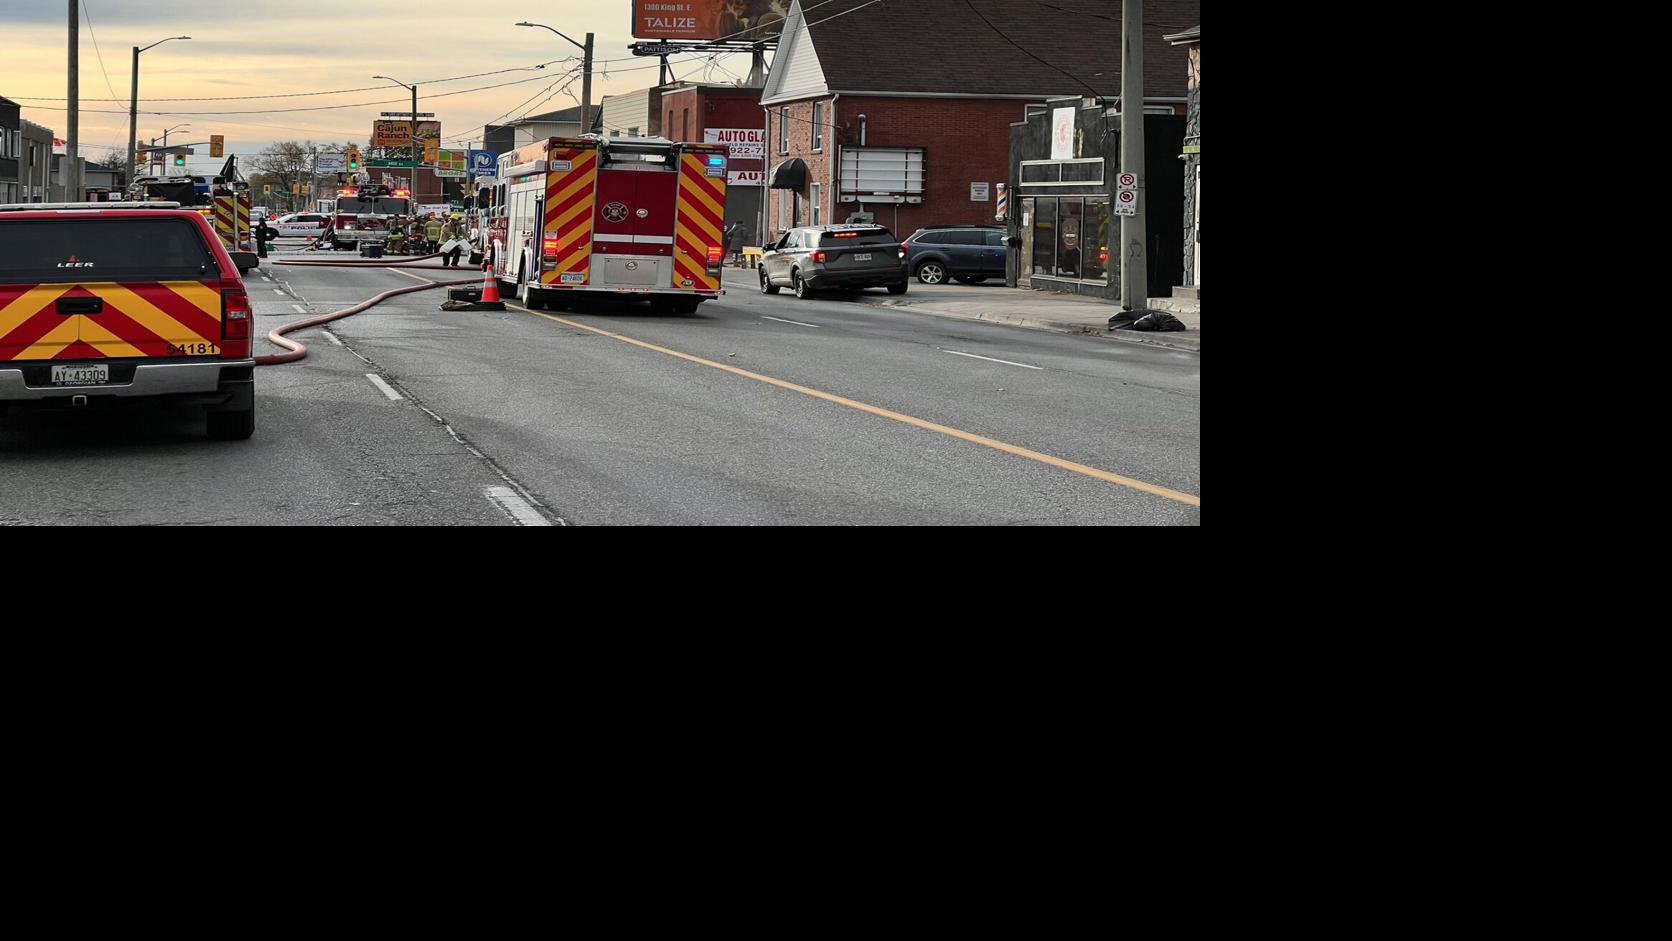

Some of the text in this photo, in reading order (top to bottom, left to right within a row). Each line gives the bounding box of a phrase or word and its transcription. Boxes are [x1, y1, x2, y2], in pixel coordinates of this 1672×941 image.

[660, 3, 676, 12] King
[643, 17, 697, 28] TALIZE
[377, 124, 407, 133] Cajun
[718, 130, 746, 142] AUTO
[168, 343, 215, 355] 54181
